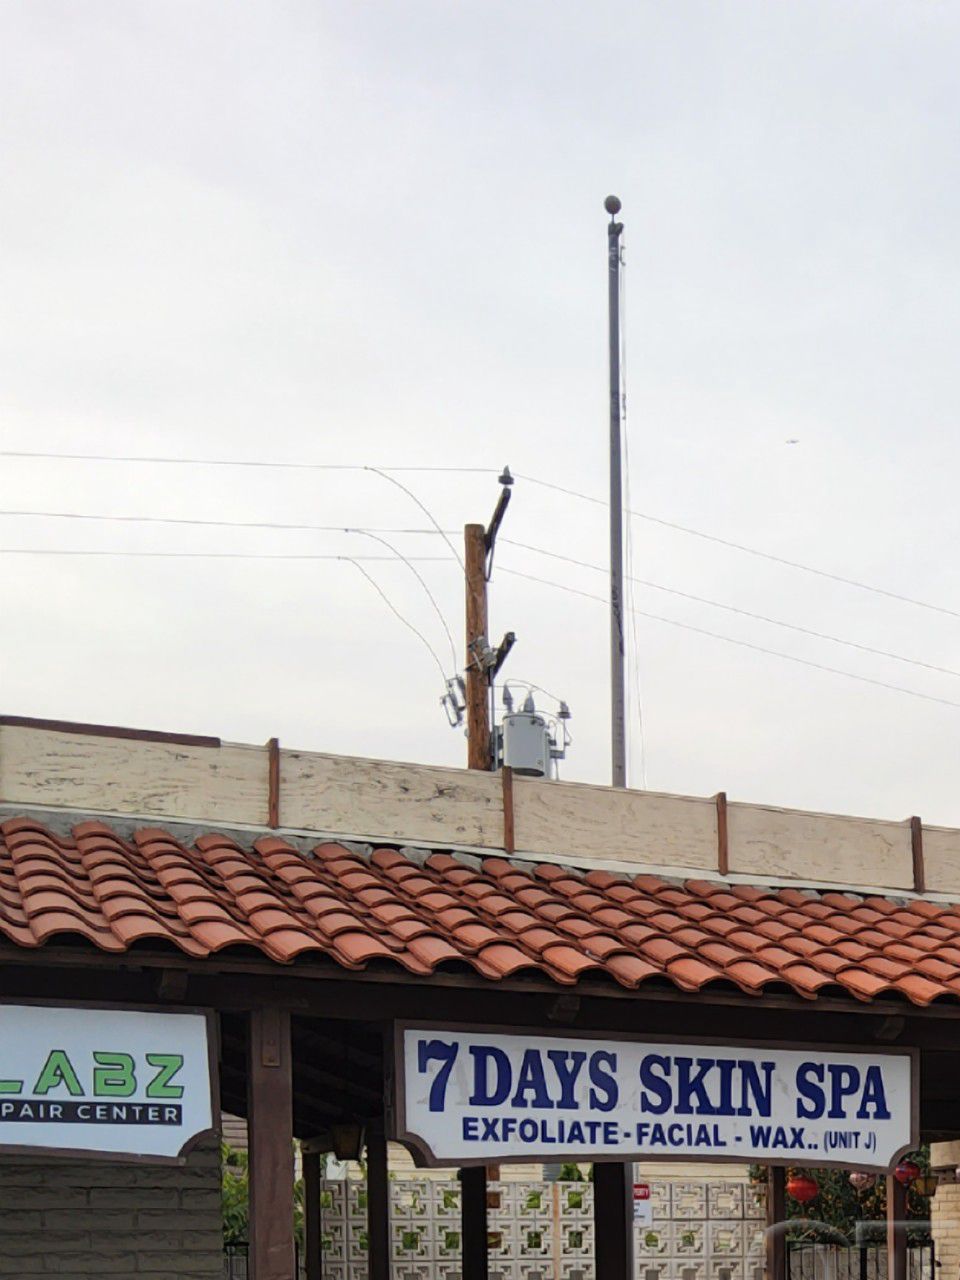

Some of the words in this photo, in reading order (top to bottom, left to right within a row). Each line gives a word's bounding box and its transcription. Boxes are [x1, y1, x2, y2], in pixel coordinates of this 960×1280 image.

[417, 1038, 460, 1113] 7
[468, 1044, 619, 1113] DAYS
[639, 1053, 777, 1118] SKIN
[795, 1061, 892, 1121] SPA
[1, 1102, 64, 1119] PAIR
[77, 1104, 178, 1122] CENTER
